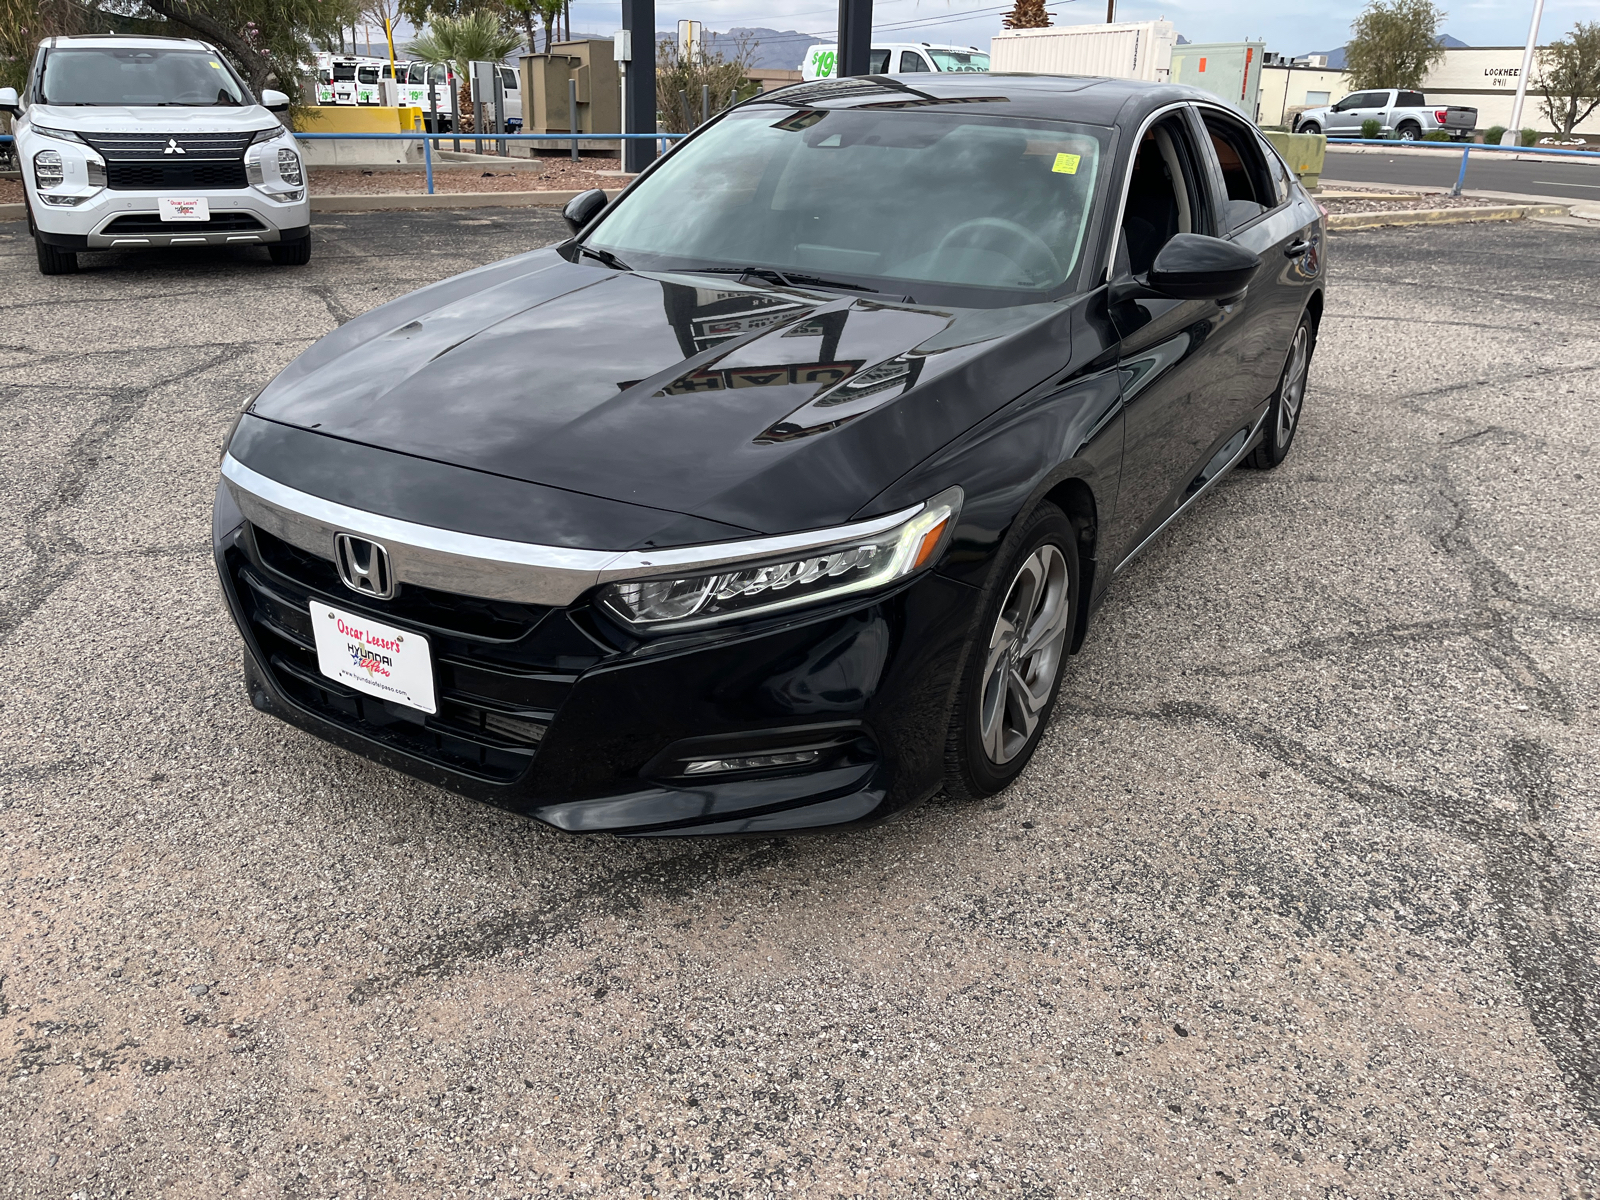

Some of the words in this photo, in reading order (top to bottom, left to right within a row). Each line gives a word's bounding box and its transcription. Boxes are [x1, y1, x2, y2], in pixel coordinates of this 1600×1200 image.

[1484, 68, 1522, 77] LOCKHEE
[337, 618, 364, 641] Oscar
[365, 629, 401, 653] Leeser's
[347, 642, 393, 667] HYUNDAI
